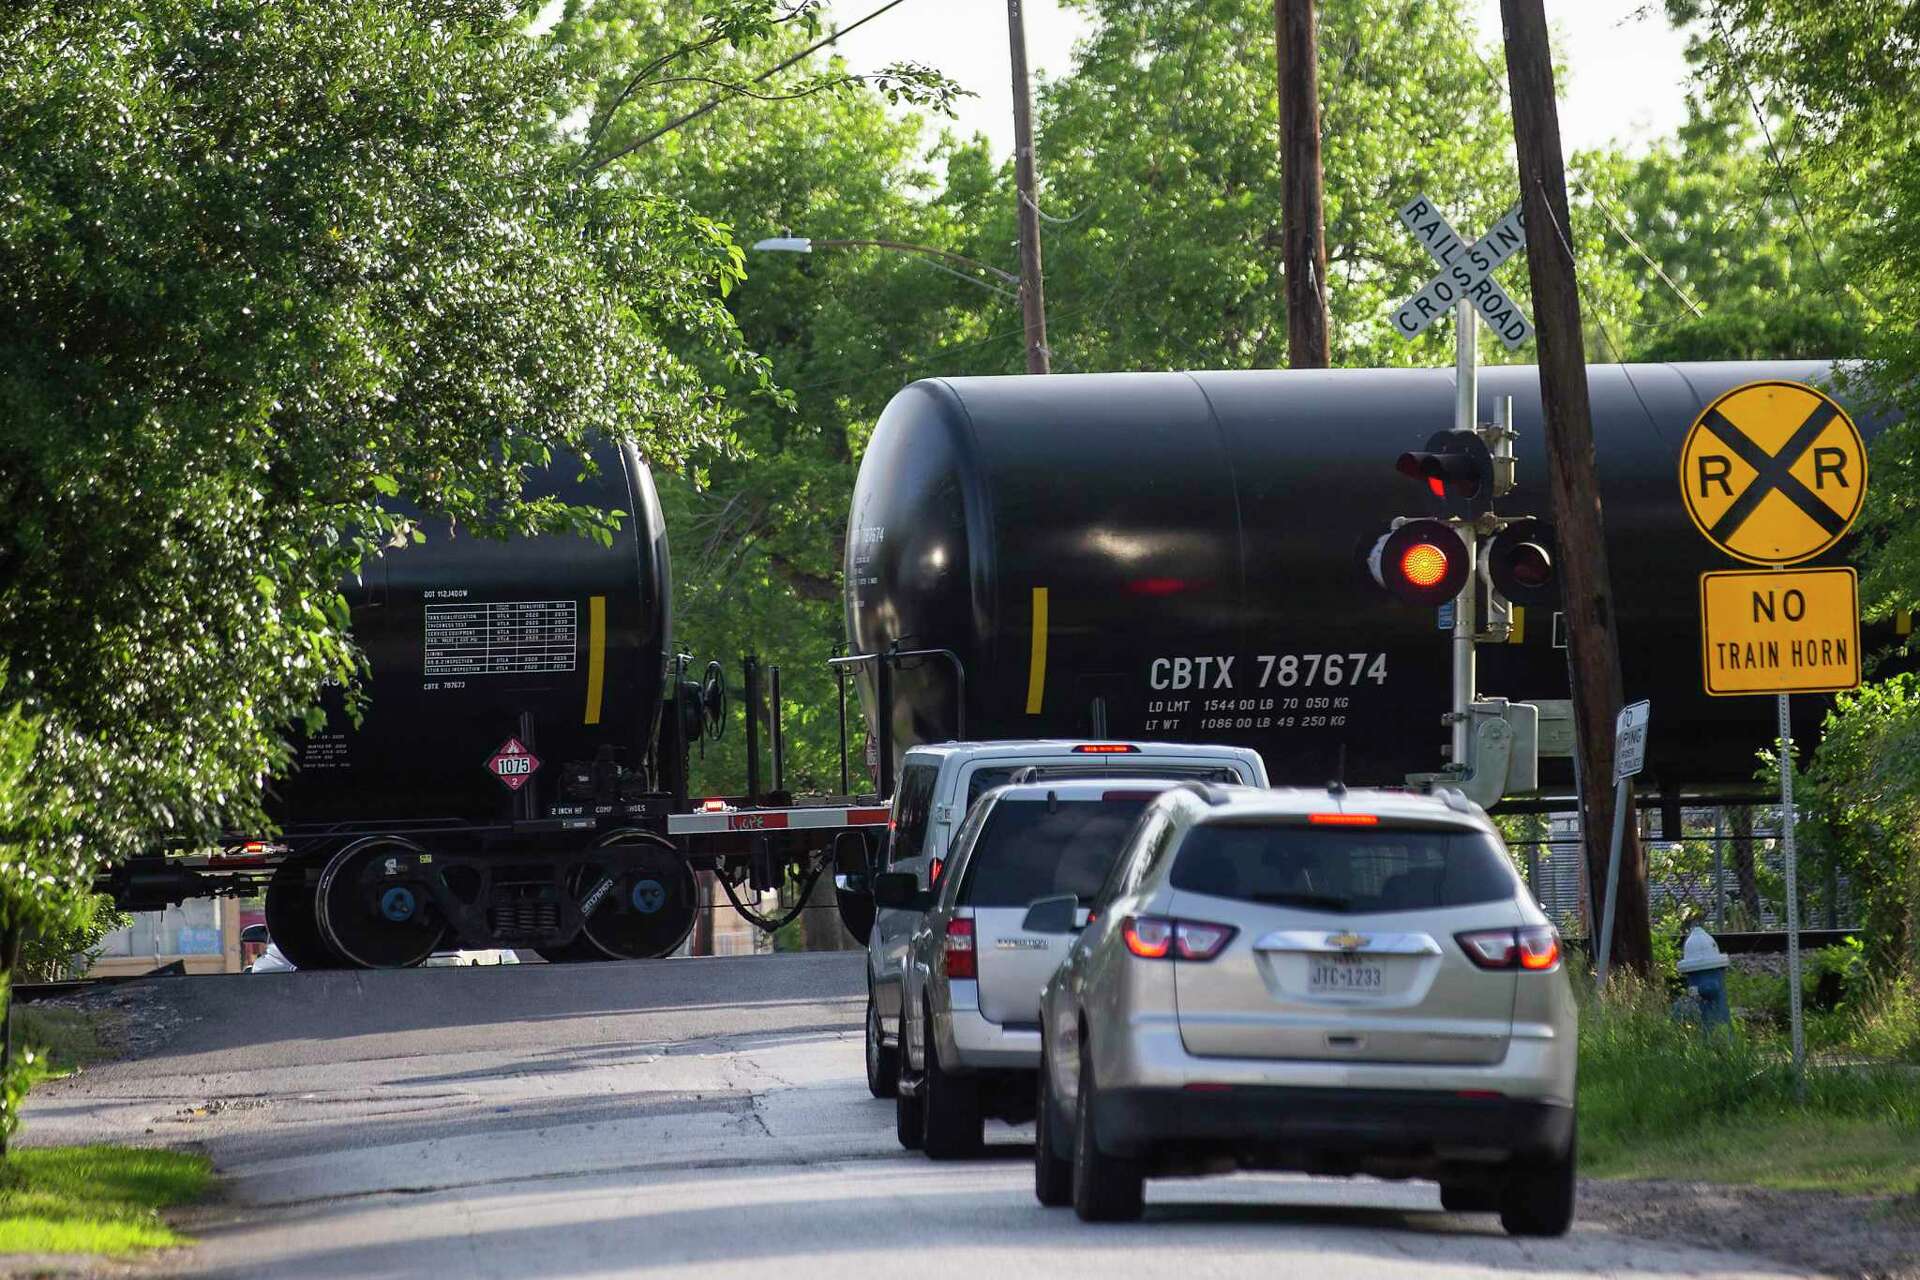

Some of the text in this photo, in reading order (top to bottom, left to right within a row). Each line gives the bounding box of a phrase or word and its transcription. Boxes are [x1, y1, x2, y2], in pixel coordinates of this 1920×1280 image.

[1698, 455, 1734, 498] R
[1814, 447, 1850, 489] R
[1752, 589, 1806, 623] NO
[1717, 638, 1848, 670] TRAIN HORN
[1150, 653, 1388, 690] CBTX 787674
[1149, 702, 1163, 712] LD
[1167, 701, 1191, 712] LMT
[1260, 699, 1274, 710] LB
[1283, 698, 1298, 709] 70
[1305, 697, 1329, 709] 050
[1333, 697, 1349, 708] KG
[1145, 720, 1157, 731] LT
[1163, 719, 1179, 730] WT
[1256, 717, 1271, 728] LB
[1330, 716, 1346, 727] KG
[499, 758, 530, 774] 1075
[512, 777, 519, 786] 2
[551, 807, 557, 815] 2
